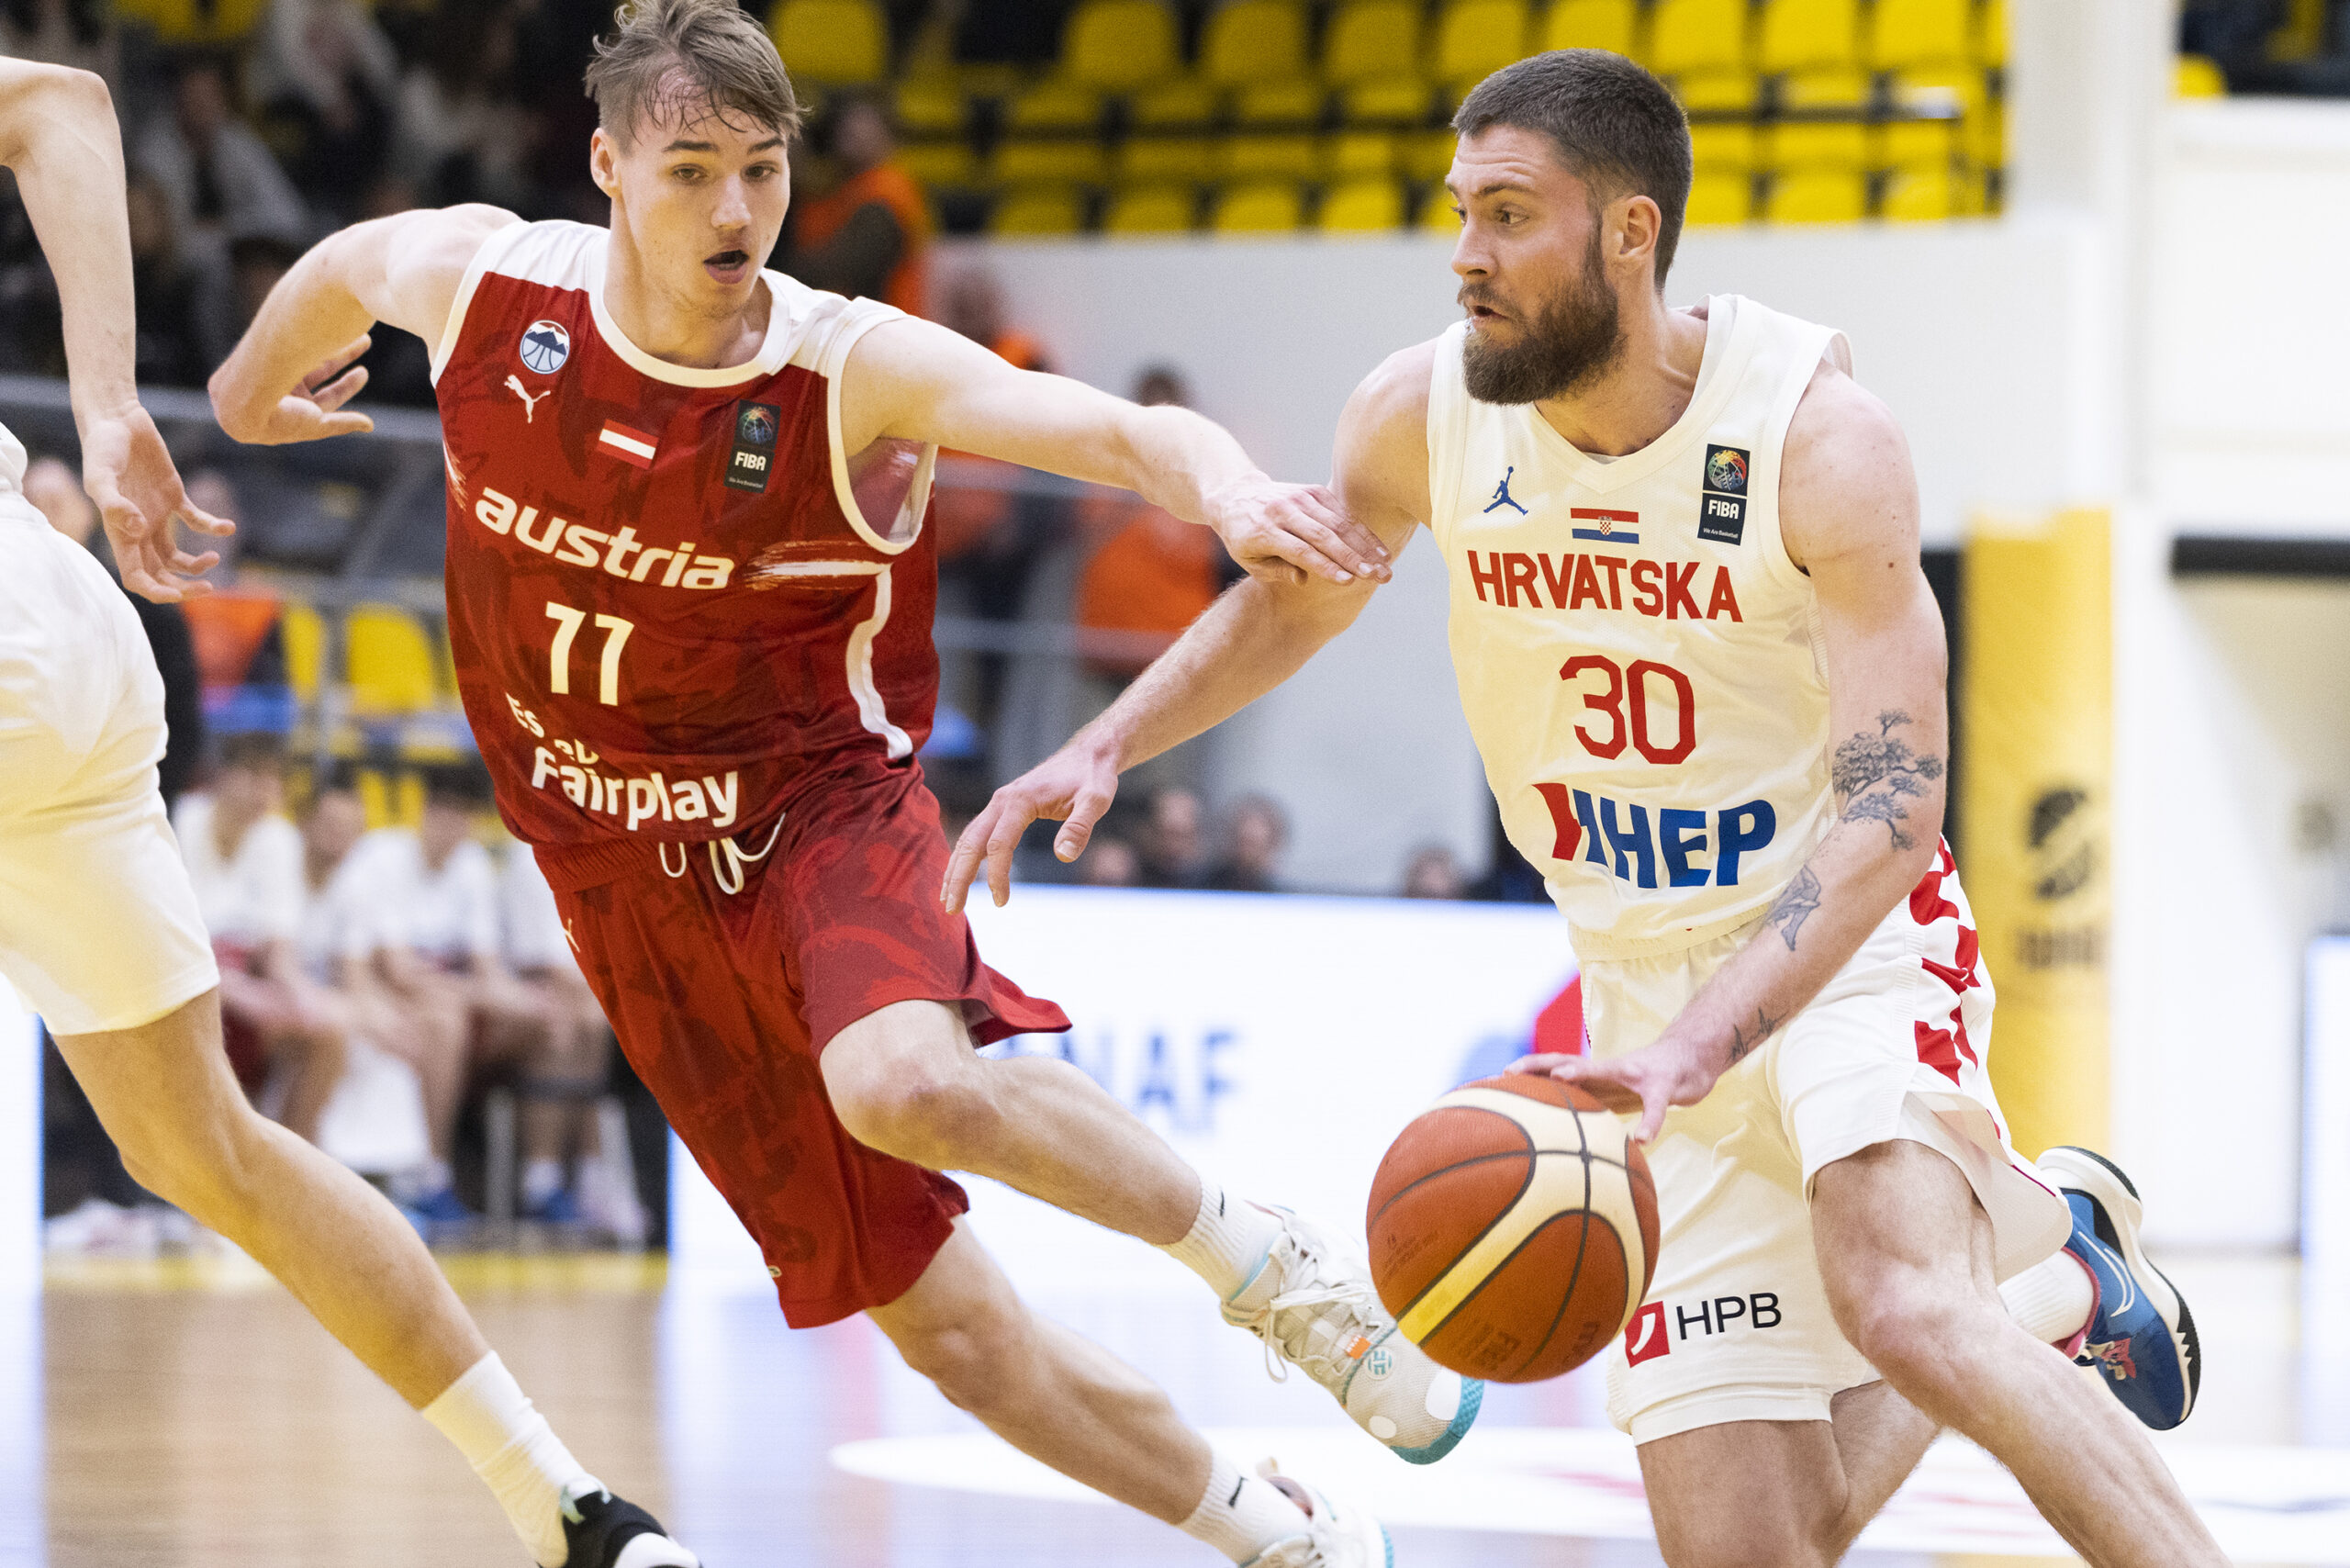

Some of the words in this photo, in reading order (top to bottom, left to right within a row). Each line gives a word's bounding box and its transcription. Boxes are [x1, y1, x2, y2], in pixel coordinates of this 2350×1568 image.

[734, 451, 767, 471] FIBA
[475, 487, 734, 589] austria
[1707, 498, 1740, 520] FIBA
[1467, 550, 1743, 622] HRVATSKA
[544, 601, 634, 706] 77
[1559, 655, 1696, 765] 30
[532, 745, 738, 832] Fairplay
[1676, 1292, 1783, 1340] HPB
